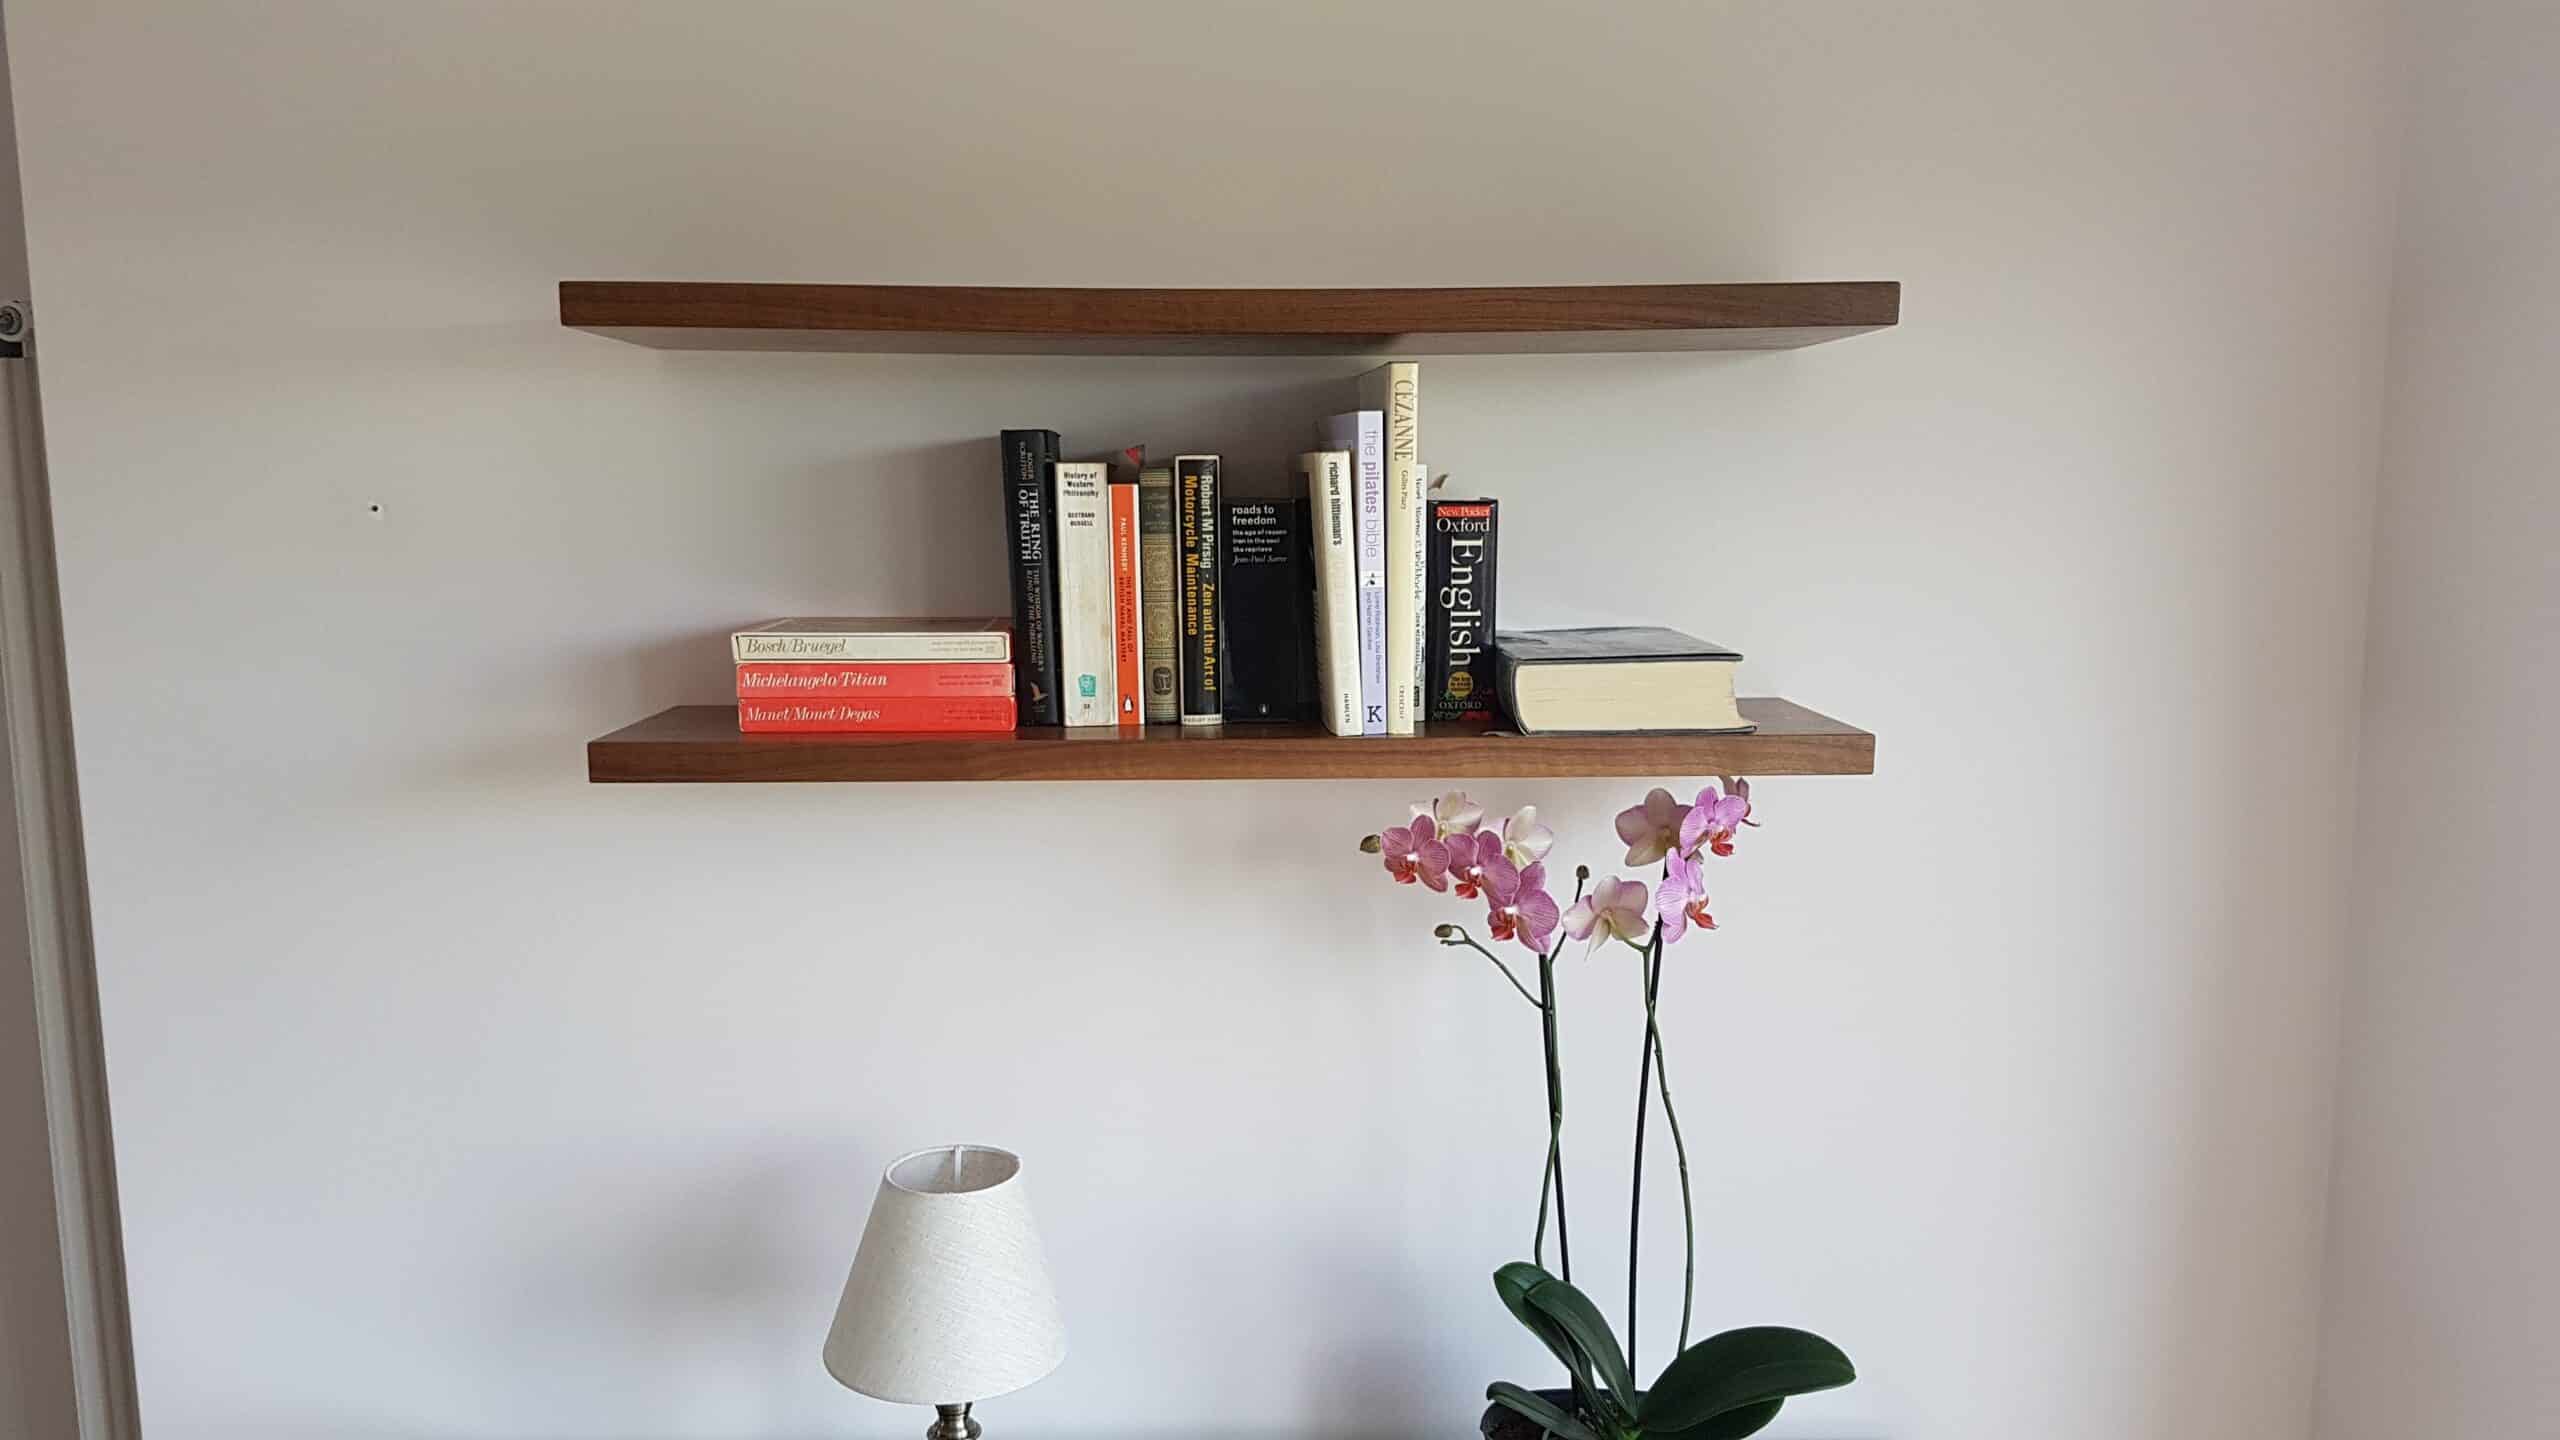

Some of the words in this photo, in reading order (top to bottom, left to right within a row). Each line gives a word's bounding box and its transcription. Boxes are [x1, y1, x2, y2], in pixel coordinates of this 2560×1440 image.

[1364, 431, 1379, 456] the
[1329, 462, 1341, 496] richard
[1362, 462, 1380, 514] pilates
[1018, 489, 1029, 508] OF
[1029, 488, 1040, 517] THE
[1201, 475, 1214, 516] Robert
[1183, 475, 1199, 547] Motorcycle
[1232, 504, 1262, 514] roads
[1264, 504, 1275, 514] to
[1232, 515, 1277, 525] freedom
[1019, 511, 1031, 560] TRUTH
[1120, 517, 1128, 536] PAUL
[1202, 519, 1214, 531] M
[1437, 518, 1490, 533] Oxford
[1031, 523, 1042, 560] RING
[1365, 519, 1382, 559] bible
[1200, 534, 1215, 569] Pirsig
[1187, 554, 1200, 636] Maintenance
[1203, 583, 1215, 606] Zen
[1440, 536, 1484, 667] English
[1204, 609, 1216, 631] and
[1204, 634, 1217, 654] the
[1205, 656, 1217, 677] Art
[1205, 679, 1218, 691] of
[1366, 705, 1383, 723] K
